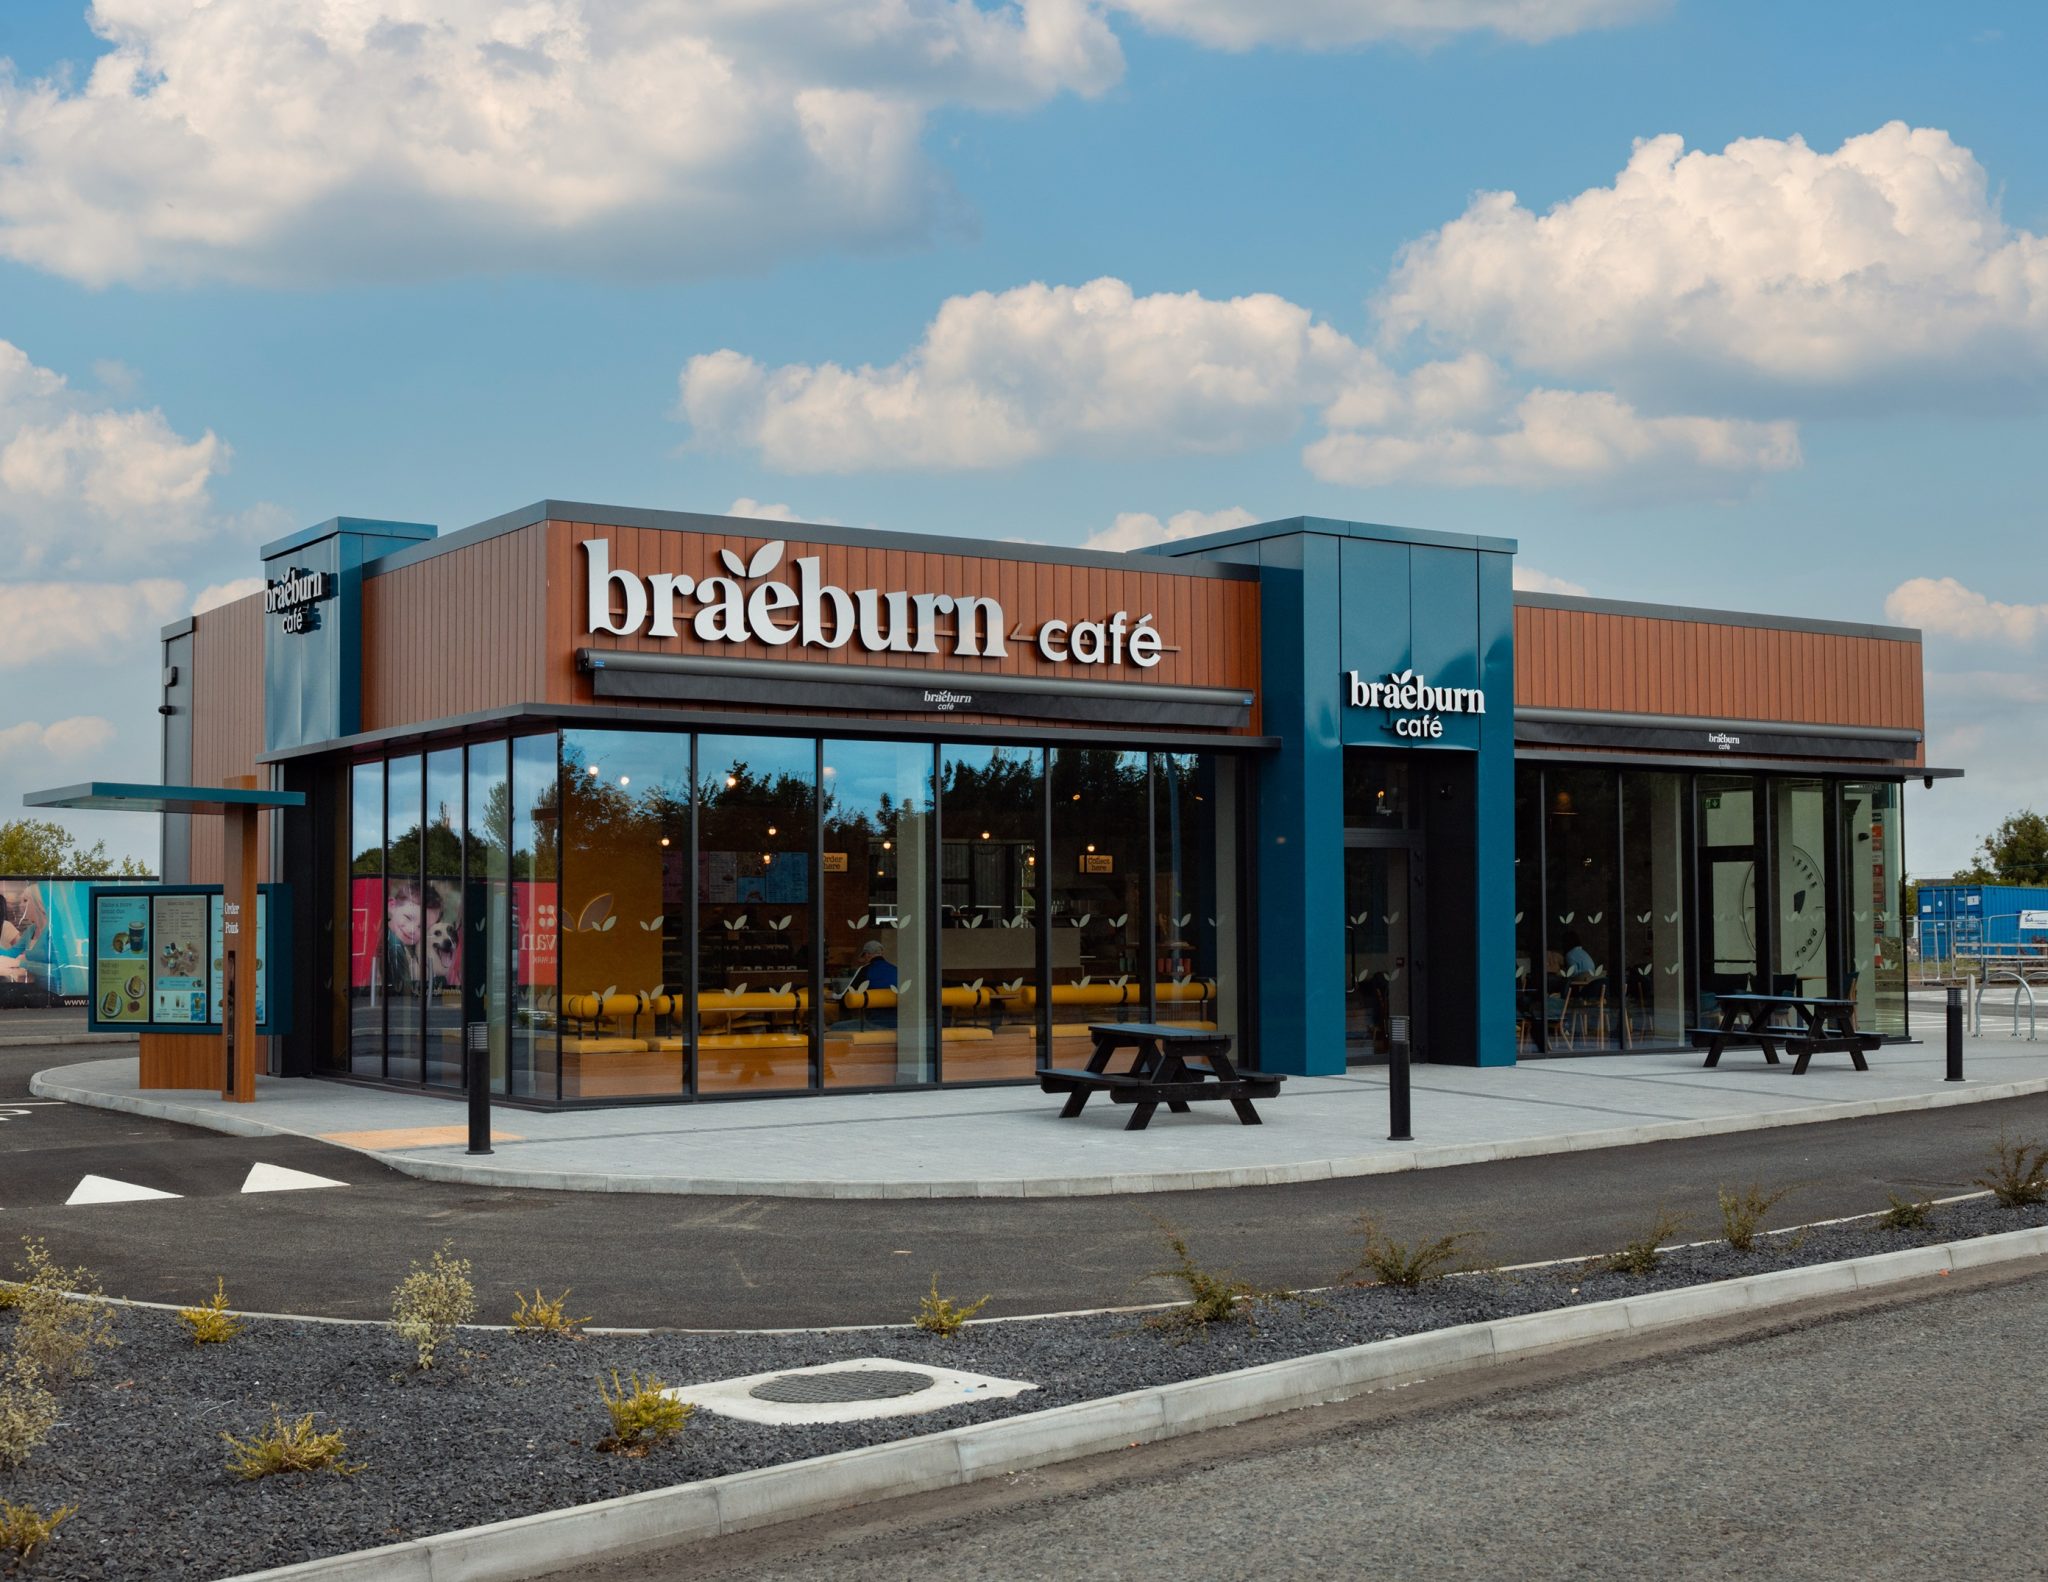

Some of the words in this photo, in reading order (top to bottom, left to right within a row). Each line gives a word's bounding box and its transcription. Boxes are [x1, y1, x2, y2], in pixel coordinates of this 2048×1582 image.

[265, 567, 322, 613] braeburn
[582, 538, 1008, 658] braeburn
[1039, 611, 1162, 667] café
[282, 606, 303, 634] café
[924, 690, 972, 703] braeburn
[1350, 669, 1486, 714] braeburn
[937, 703, 955, 711] café
[1396, 714, 1443, 738] café
[1708, 732, 1740, 744] braeburn
[224, 902, 240, 915] Order
[224, 921, 239, 934] Point
